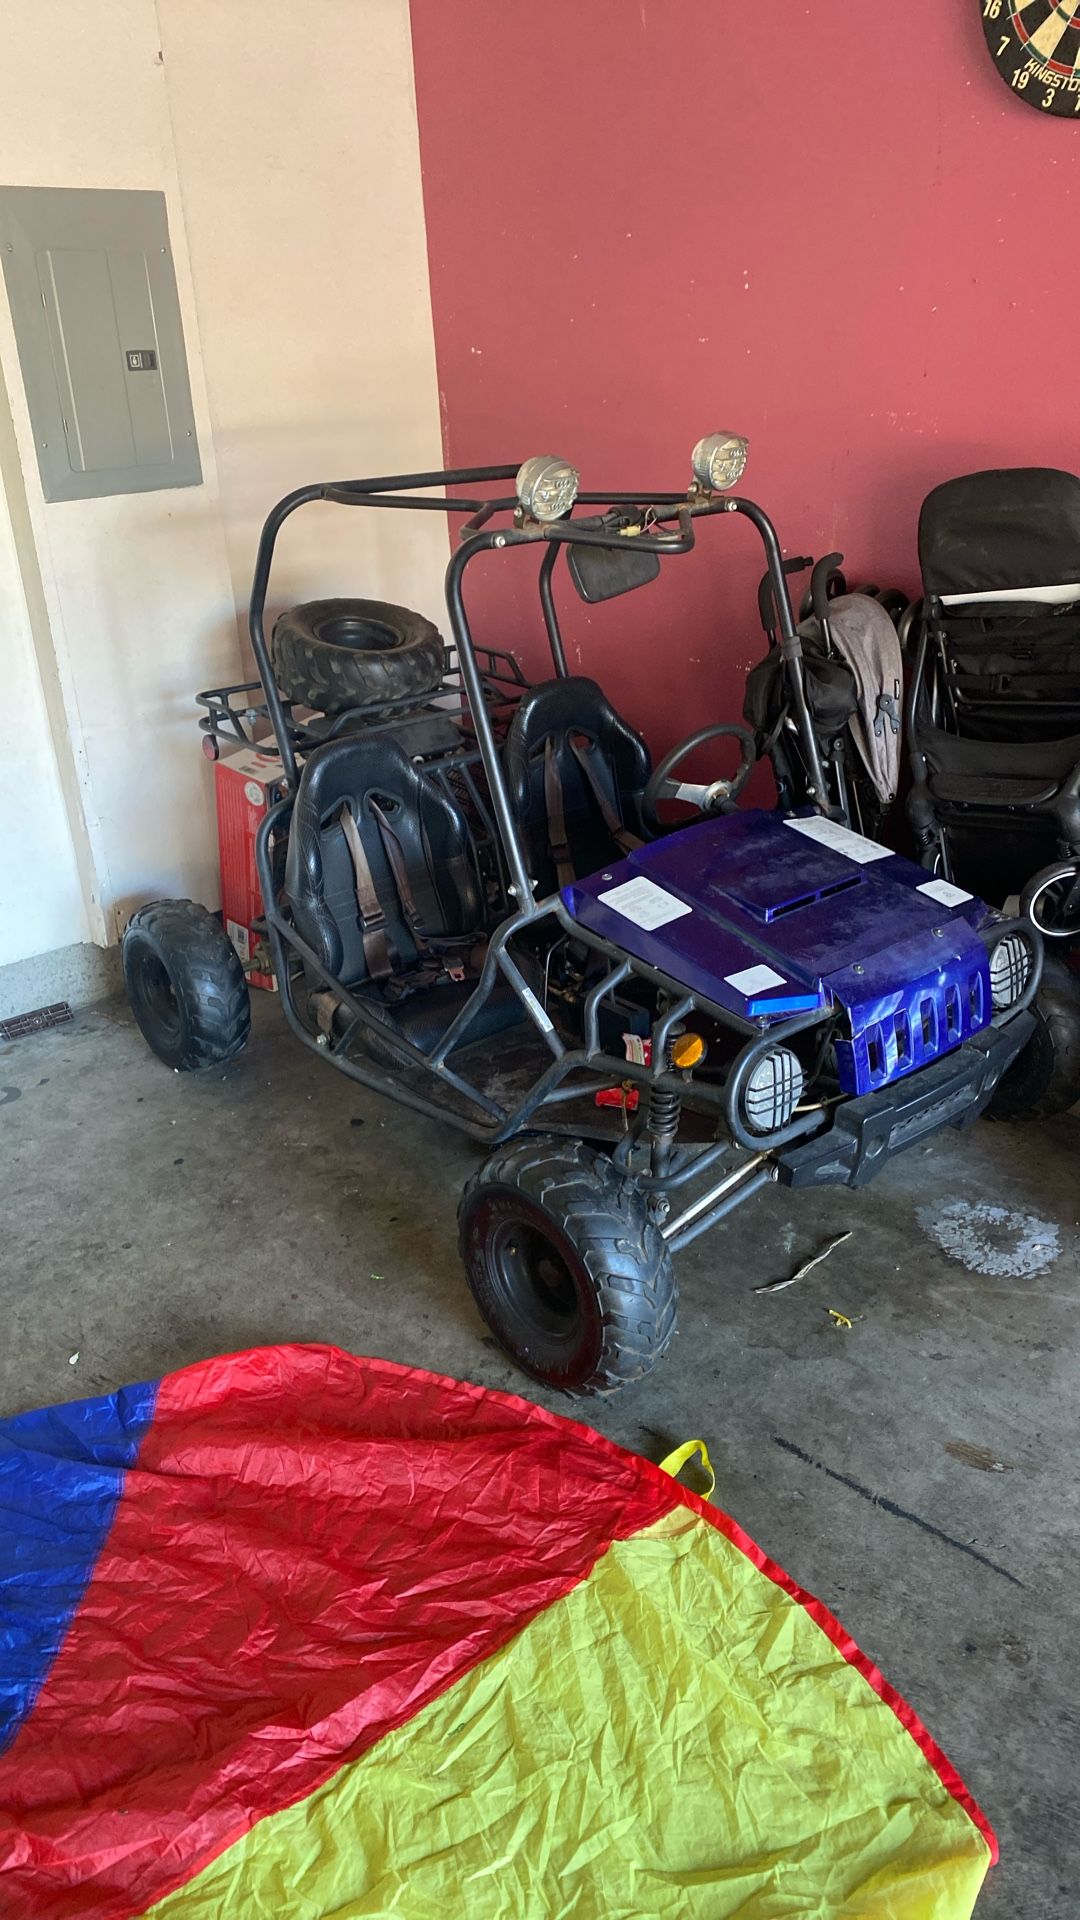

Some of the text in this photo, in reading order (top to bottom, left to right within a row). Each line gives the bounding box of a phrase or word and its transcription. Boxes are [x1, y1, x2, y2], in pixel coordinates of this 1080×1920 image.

[983, 0, 1002, 19] 16
[996, 35, 1011, 56] 7
[1011, 68, 1030, 89] 19
[1024, 58, 1080, 92] KINGSTO
[1041, 88, 1056, 107] 3
